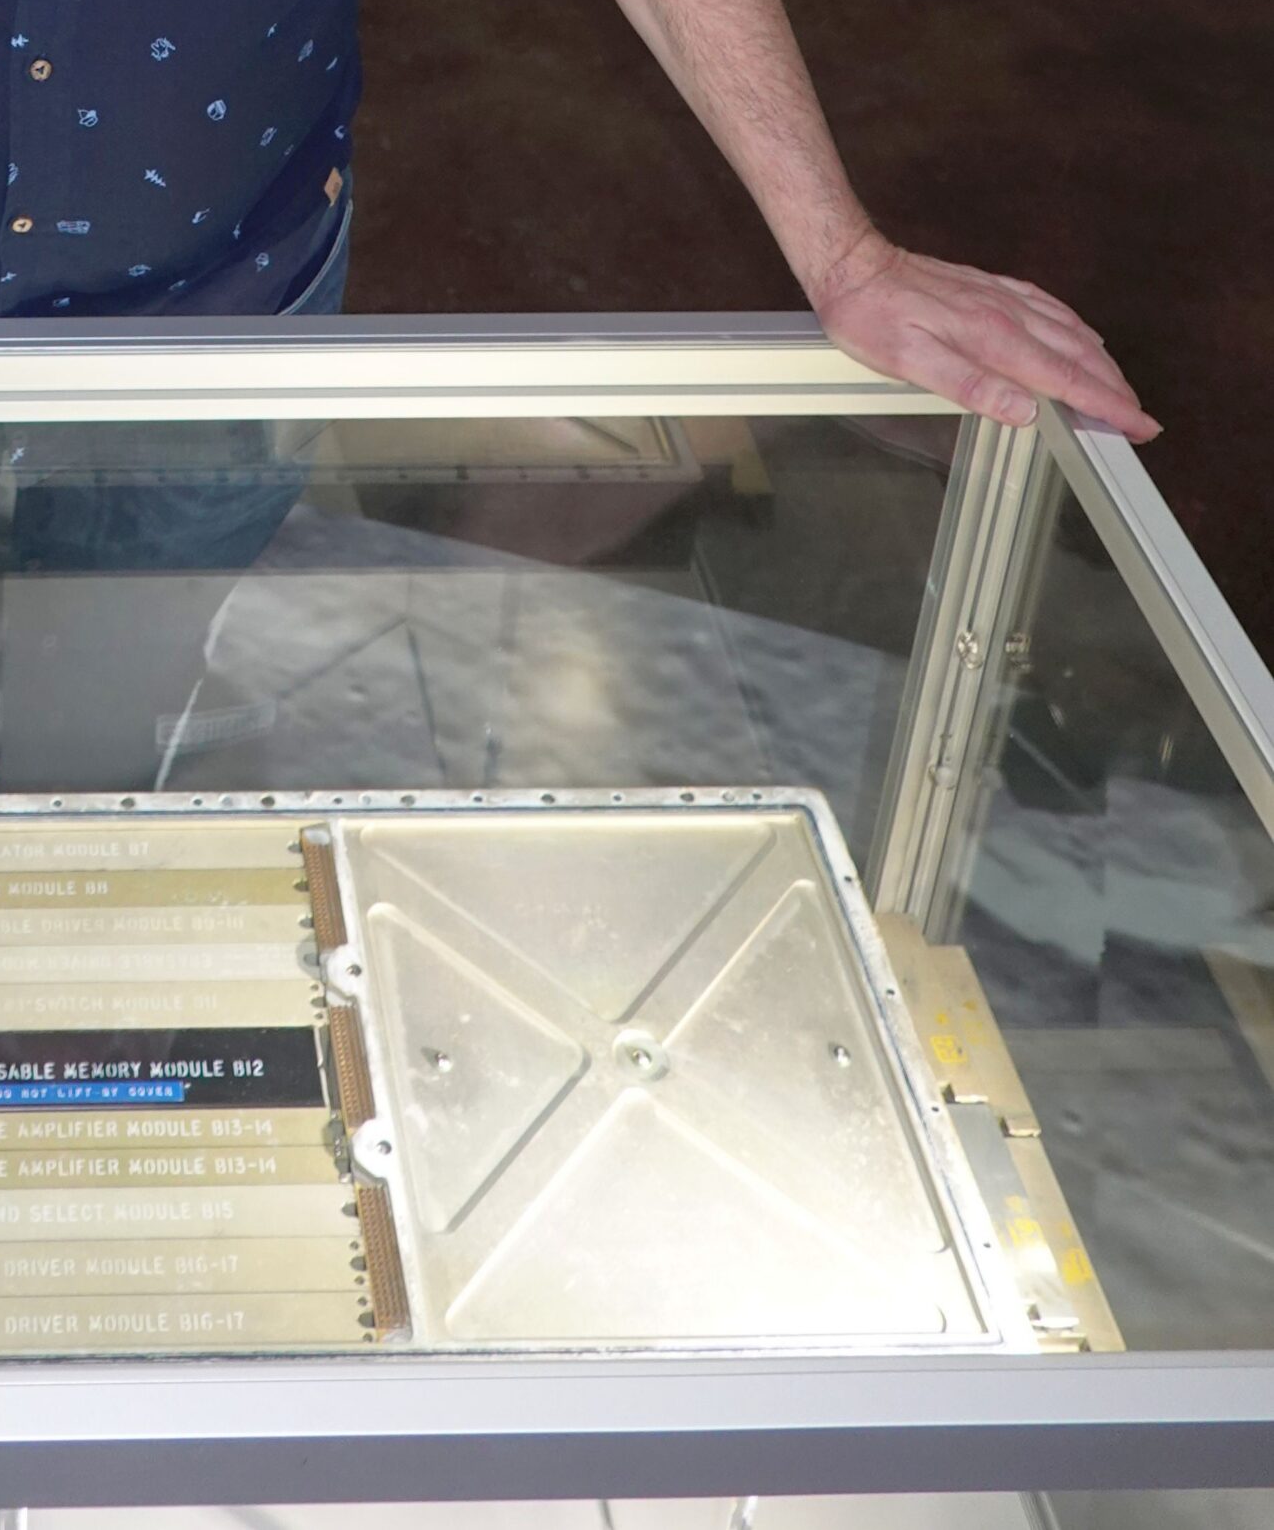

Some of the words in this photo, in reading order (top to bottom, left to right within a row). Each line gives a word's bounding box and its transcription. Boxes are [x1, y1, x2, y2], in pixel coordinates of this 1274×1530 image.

[54, 842, 120, 857] MODULE
[8, 881, 77, 896] MODULE
[112, 916, 183, 933] MODULE
[63, 1060, 142, 1079] MEMORY
[150, 1059, 225, 1078] MODULE
[232, 1058, 265, 1077] B12
[20, 1087, 47, 1099] NOT
[128, 1085, 173, 1098] COVER
[18, 1119, 117, 1139] AMPLIFIER
[127, 1119, 203, 1137] MODULE
[212, 1118, 273, 1137] B13-14
[18, 1158, 120, 1178] AMPLIFIER
[129, 1157, 205, 1176] MODULE
[215, 1156, 277, 1175] B13-14
[30, 1203, 103, 1223] SELECT
[114, 1201, 191, 1221] MODULE
[202, 1200, 234, 1219] B15
[4, 1258, 76, 1277] DRIVER
[86, 1256, 166, 1276] MODULE
[5, 1314, 79, 1335] DRIVER
[88, 1312, 170, 1334] MODULE
[179, 1311, 246, 1333] B16-17
